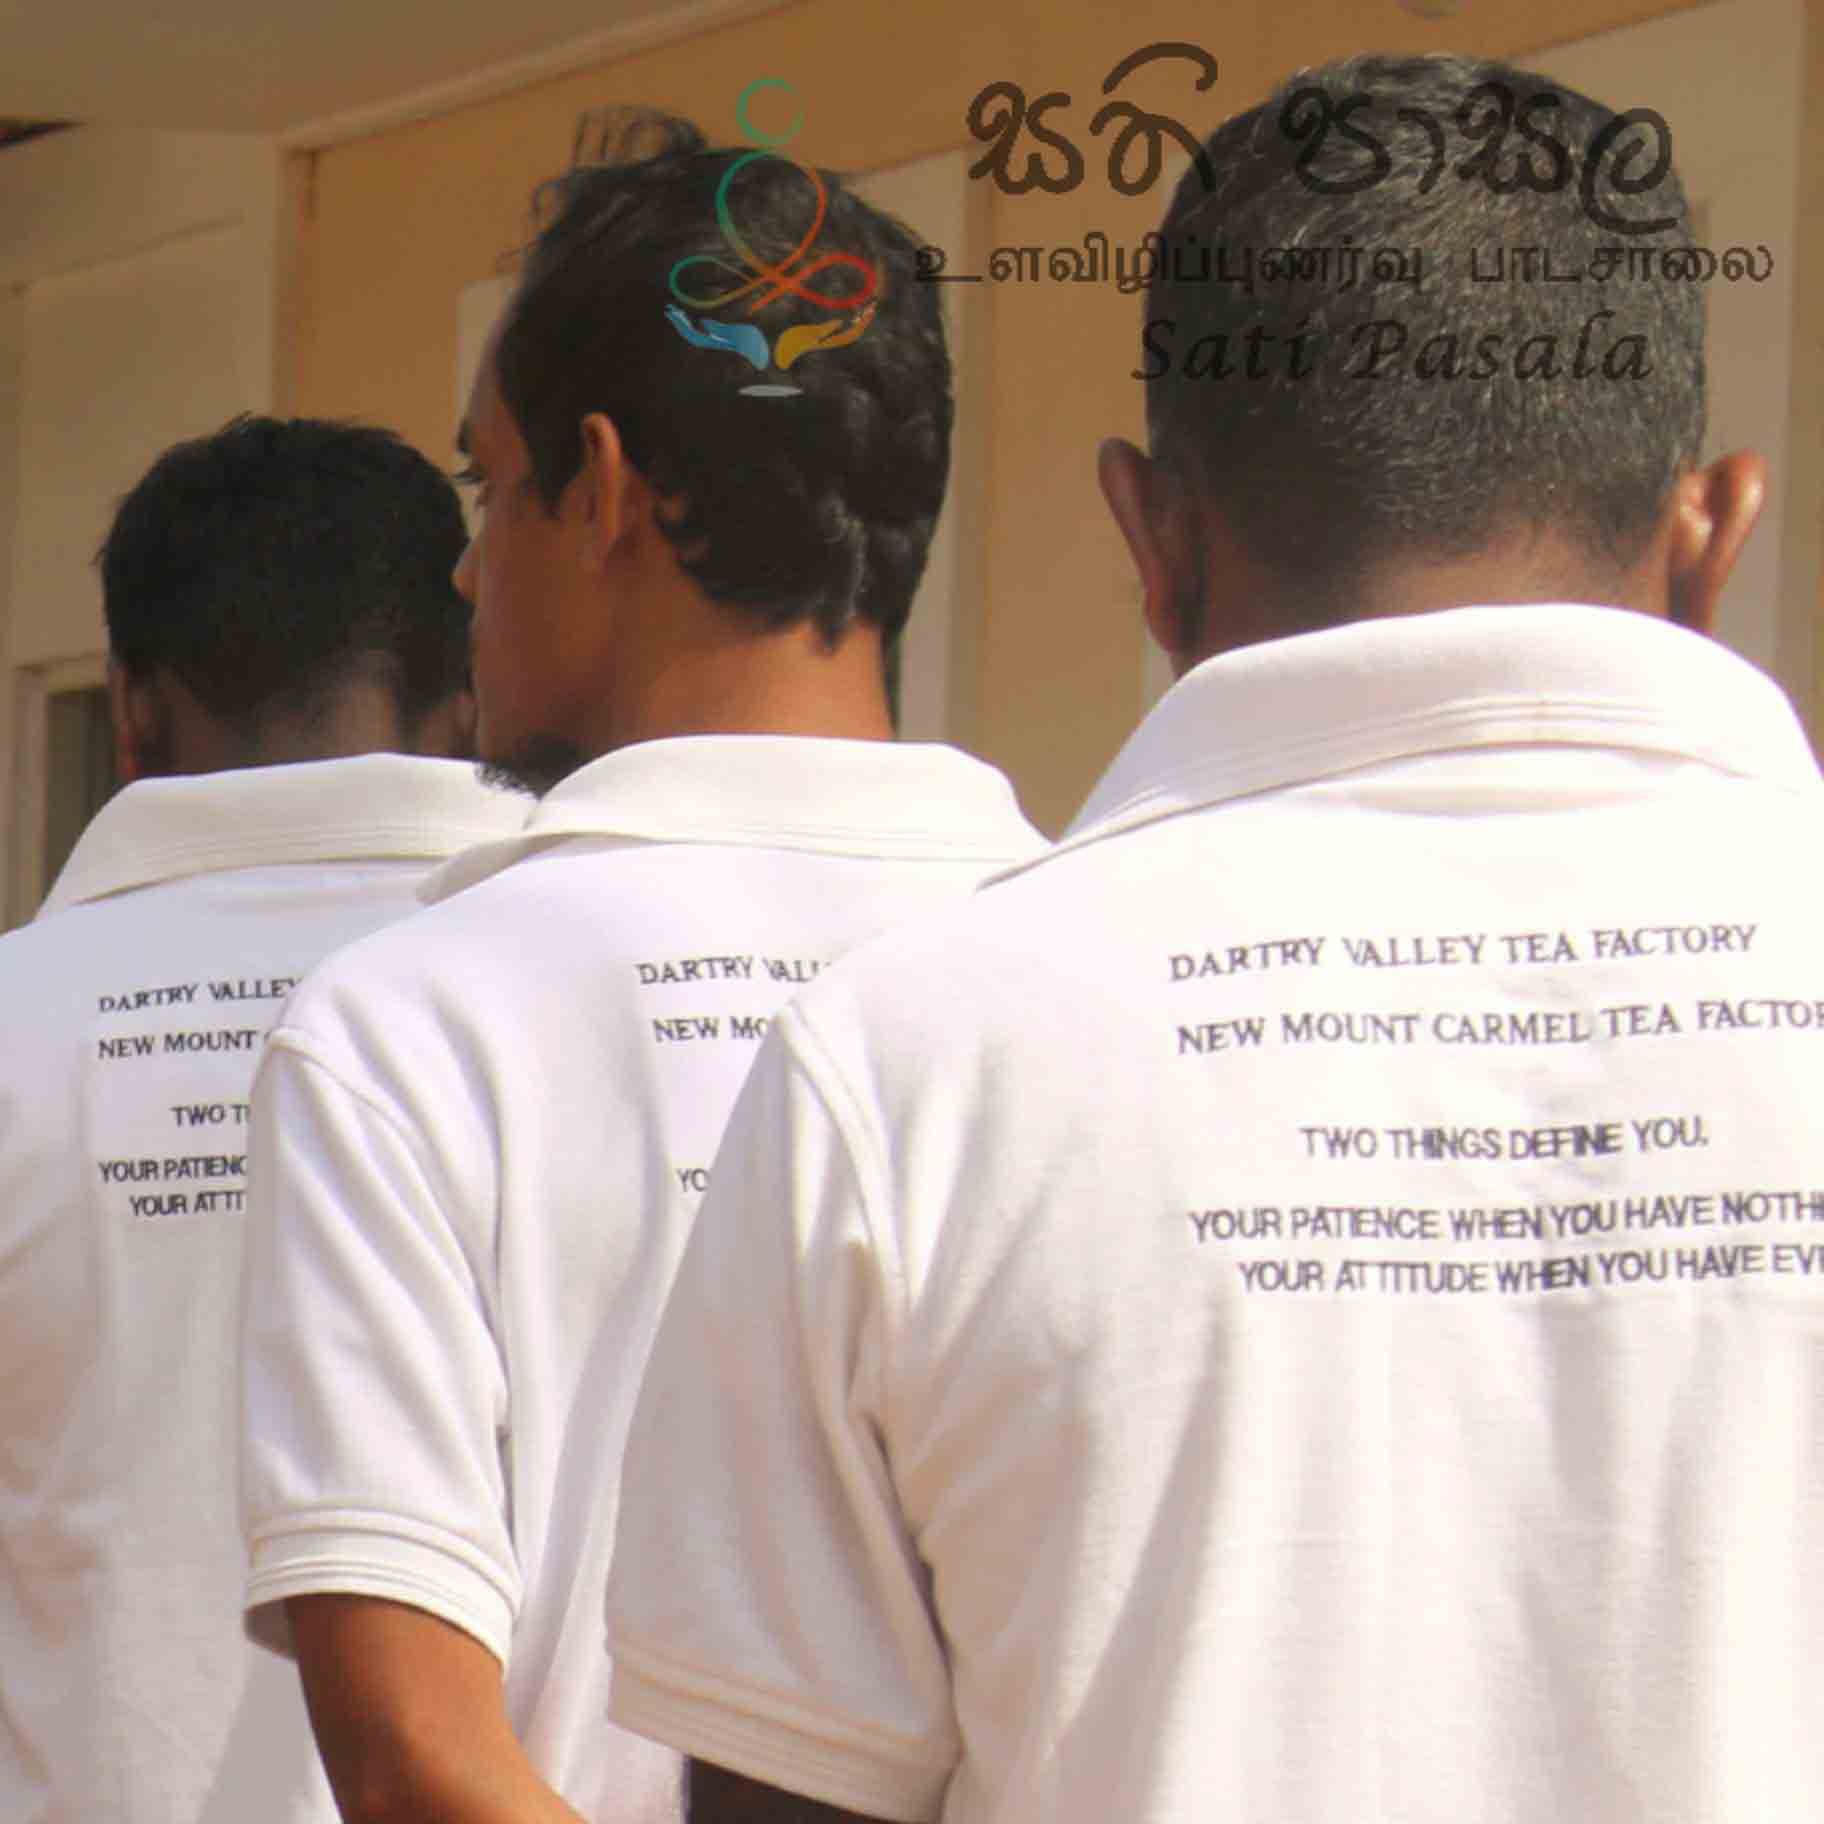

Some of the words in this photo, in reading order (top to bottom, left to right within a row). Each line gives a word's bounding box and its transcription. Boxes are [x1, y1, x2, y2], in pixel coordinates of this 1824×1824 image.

[1168, 935, 1326, 982] DARTRY
[1341, 932, 1487, 967] VALLEY
[1499, 931, 1579, 964] TEA
[1591, 922, 1759, 959] FACTORY
[634, 956, 754, 985] DARTRY
[99, 984, 199, 1013] DARTRY
[652, 1015, 721, 1043] NEW
[1176, 1016, 1266, 1055] NEW
[1280, 1011, 1422, 1044] MOUNT
[1432, 1011, 1593, 1045] CARMEL
[1600, 1003, 1682, 1039] TEA
[98, 1035, 156, 1060] NEW
[164, 1029, 260, 1053] MOUNT
[170, 1104, 228, 1127] TWO
[1300, 1127, 1380, 1159] TWO
[1384, 1127, 1502, 1160] THINGS
[1509, 1122, 1624, 1160] DEFINE
[1631, 1115, 1710, 1152] YOU.
[98, 1159, 159, 1184] YOUR
[129, 1193, 187, 1217] YOUR
[1188, 1208, 1281, 1243] YOUR
[1291, 1205, 1441, 1240] PATIENCE
[1448, 1207, 1544, 1241] WHEN
[1550, 1202, 1618, 1239] YOU
[1624, 1195, 1716, 1230] HAVE
[1237, 1260, 1326, 1294] YOUR
[1496, 1254, 1590, 1294] WHEN
[1598, 1248, 1669, 1284] YOU
[1676, 1243, 1765, 1280] HAVE
